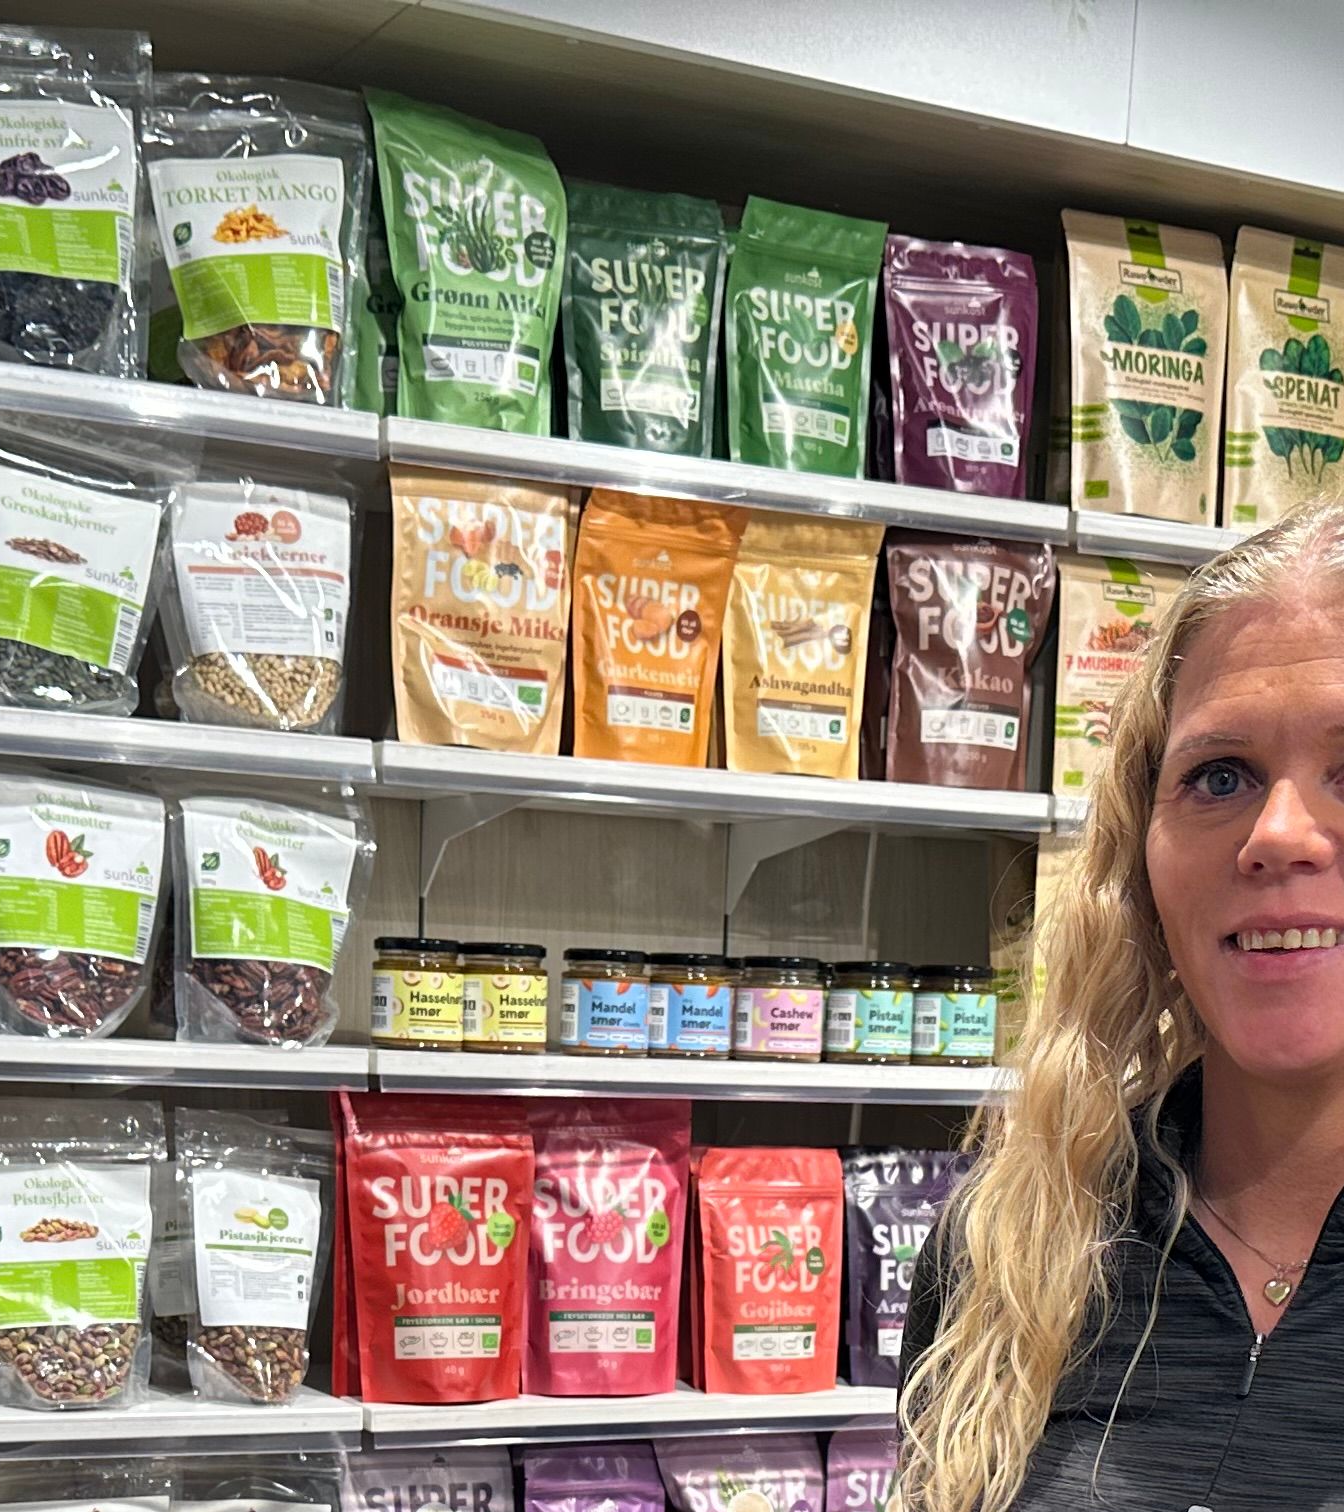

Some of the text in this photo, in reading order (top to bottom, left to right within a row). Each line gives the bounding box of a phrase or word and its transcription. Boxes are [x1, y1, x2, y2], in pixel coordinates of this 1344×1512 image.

[163, 181, 337, 209] TØRKET MANGO
[403, 168, 547, 239] SUPER
[411, 282, 490, 311] Grønn
[1111, 348, 1205, 386] MORINGA
[1273, 375, 1340, 406] SPENAT
[0, 495, 117, 537] Gresskarkjerner
[85, 566, 139, 595] sunkost
[598, 659, 701, 688] Gurkemei
[936, 665, 1014, 694] Kakao
[749, 673, 853, 698] Ashwagandha
[103, 867, 154, 886] sunkost
[409, 1006, 441, 1019] smør
[499, 1007, 529, 1020] smør
[591, 999, 636, 1015] Mandel
[681, 1004, 724, 1019] Mandel
[771, 1006, 814, 1021] Cashew
[868, 1009, 904, 1026] Pistasj
[590, 1014, 623, 1027] smør
[680, 1017, 712, 1030] smør
[770, 1020, 800, 1032] smør
[868, 1022, 898, 1034] smør
[953, 1024, 982, 1037] smør
[954, 1011, 988, 1027] Pistasj
[372, 1174, 509, 1220] SUPER
[384, 1222, 507, 1268] FOOD
[390, 1281, 502, 1312] Jordbær
[538, 1277, 663, 1307] Bringebær
[740, 1300, 815, 1322] Gojibær
